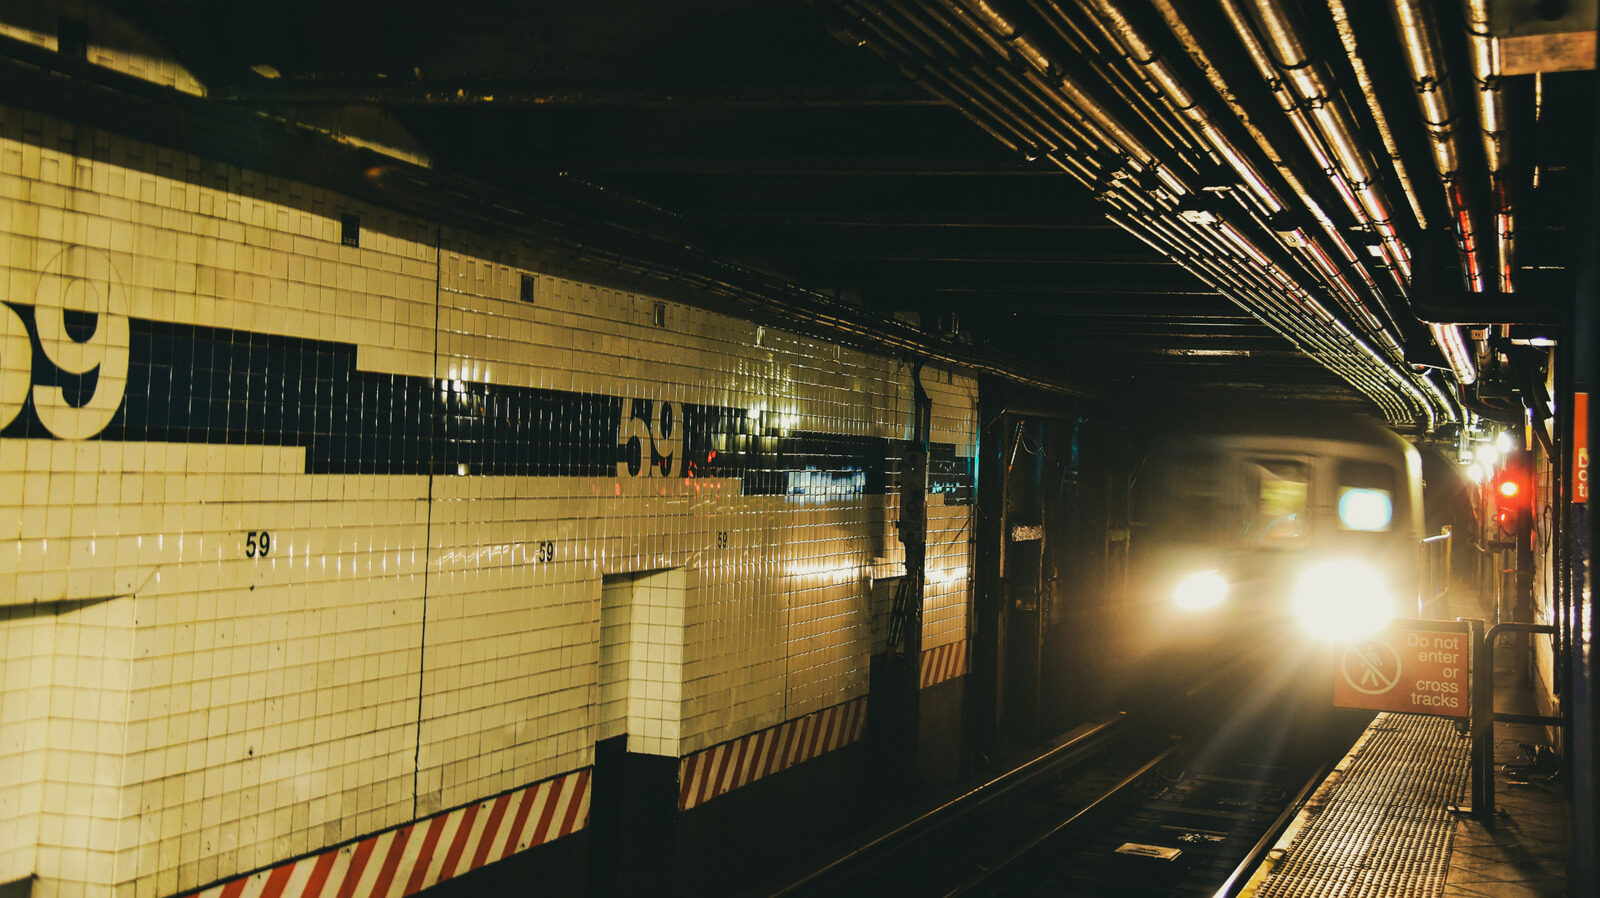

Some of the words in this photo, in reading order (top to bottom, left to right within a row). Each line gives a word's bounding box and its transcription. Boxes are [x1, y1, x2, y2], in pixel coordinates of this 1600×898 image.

[616, 383, 683, 496] 59
[245, 531, 271, 558] 59
[717, 531, 728, 550] 59
[538, 540, 554, 563] 59
[1407, 633, 1429, 648] Do
[1434, 637, 1459, 650] not
[1418, 651, 1459, 664] enter
[1442, 667, 1459, 679] or
[1416, 680, 1459, 693] cross
[1411, 692, 1459, 708] tracks
